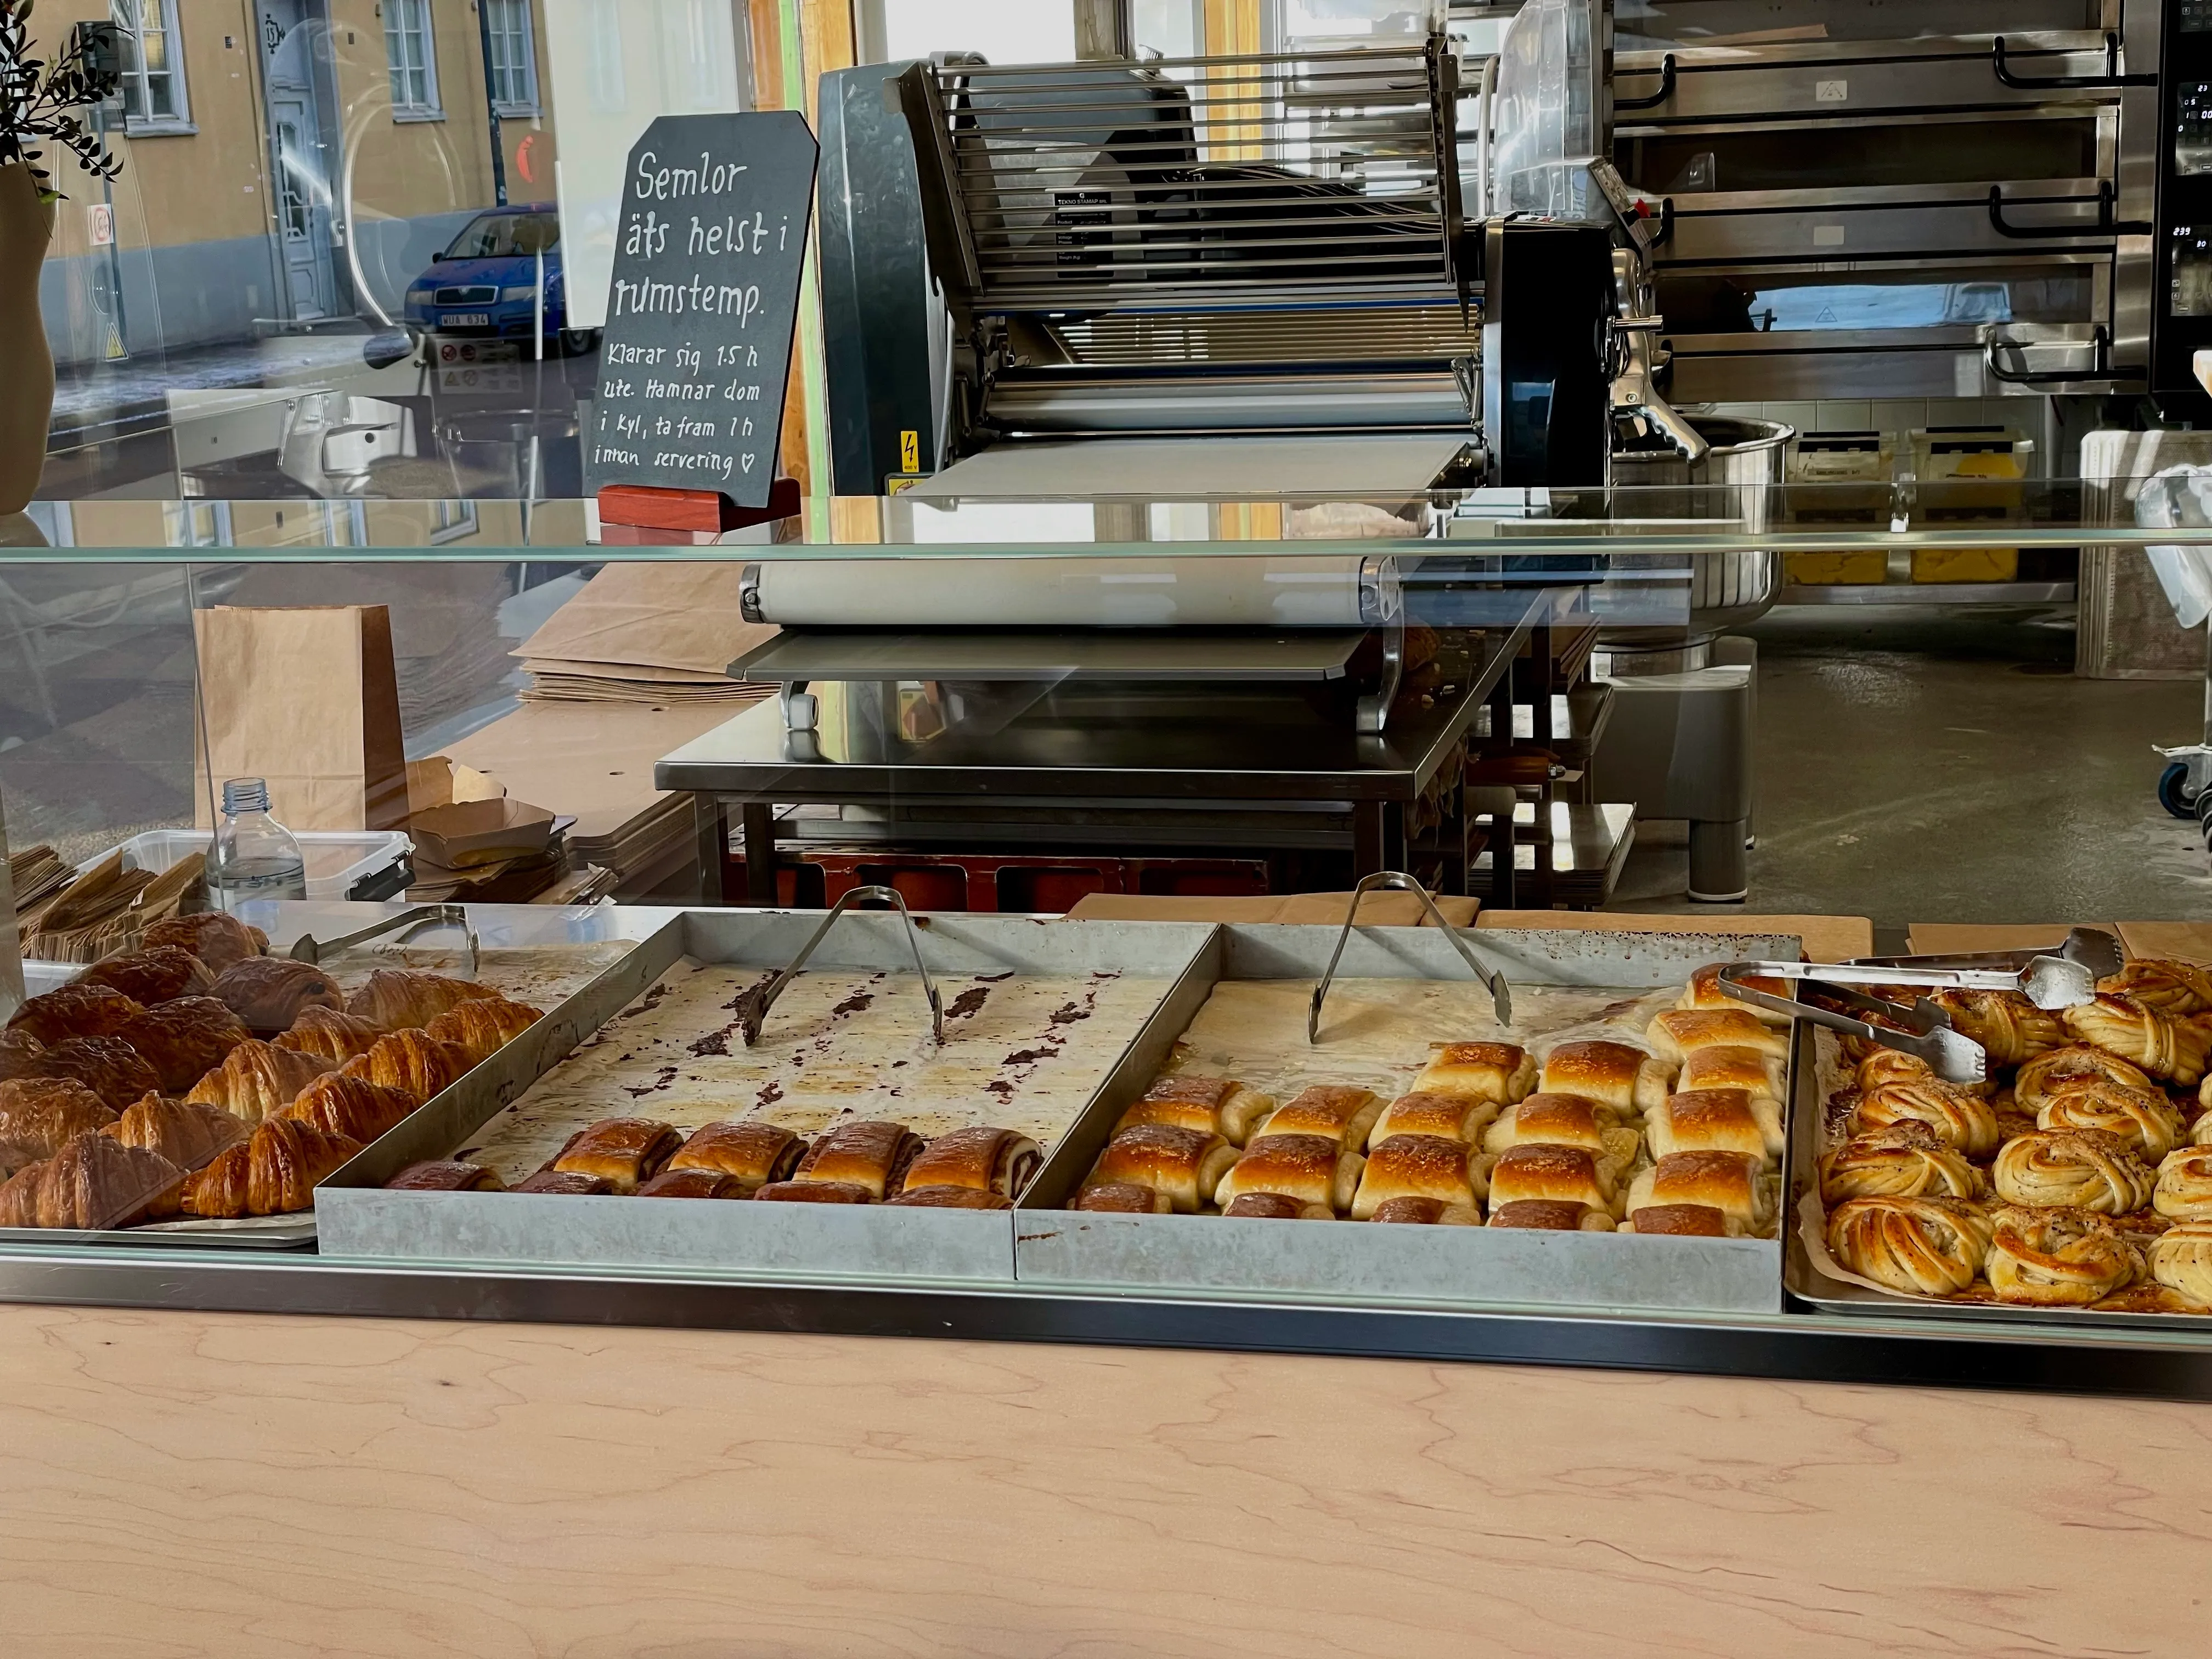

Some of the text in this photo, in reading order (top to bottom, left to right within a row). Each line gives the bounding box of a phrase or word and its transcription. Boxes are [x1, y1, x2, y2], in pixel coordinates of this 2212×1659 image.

[636, 152, 748, 200] Semlor
[626, 211, 788, 259] äts helst i
[2173, 227, 2191, 236] 239
[615, 273, 765, 329] rumstemp.
[607, 343, 667, 365] Klarar
[675, 342, 701, 376] sig
[747, 345, 758, 367] h
[604, 378, 760, 401] ute. Hamnar dom
[601, 410, 608, 431] i
[656, 416, 672, 435] ta
[676, 415, 715, 438] fram
[742, 416, 753, 436] h
[654, 451, 733, 481] servering
